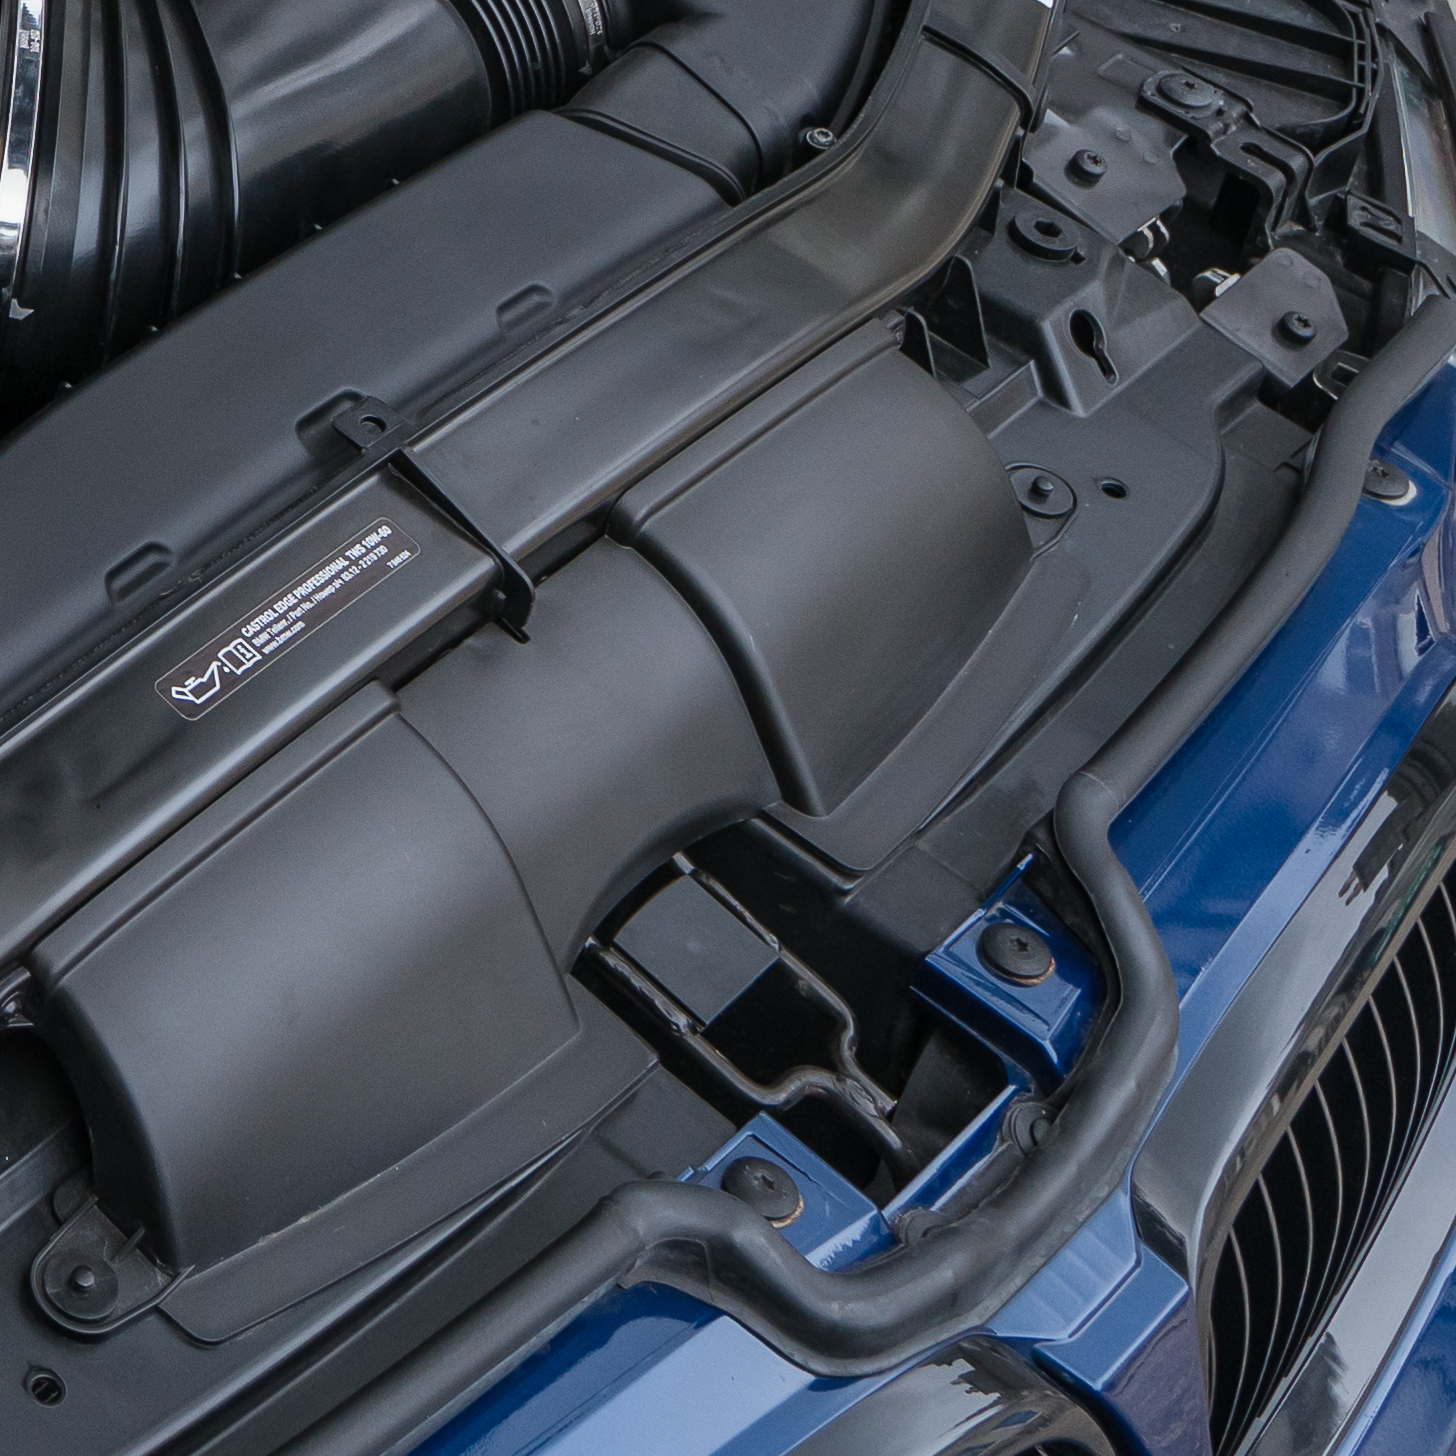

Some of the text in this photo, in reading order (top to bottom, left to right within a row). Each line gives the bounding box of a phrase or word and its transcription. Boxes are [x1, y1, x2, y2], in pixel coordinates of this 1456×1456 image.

[240, 523, 392, 639] CASTROL EDGE PROFESSIONAL TWS 10W-60
